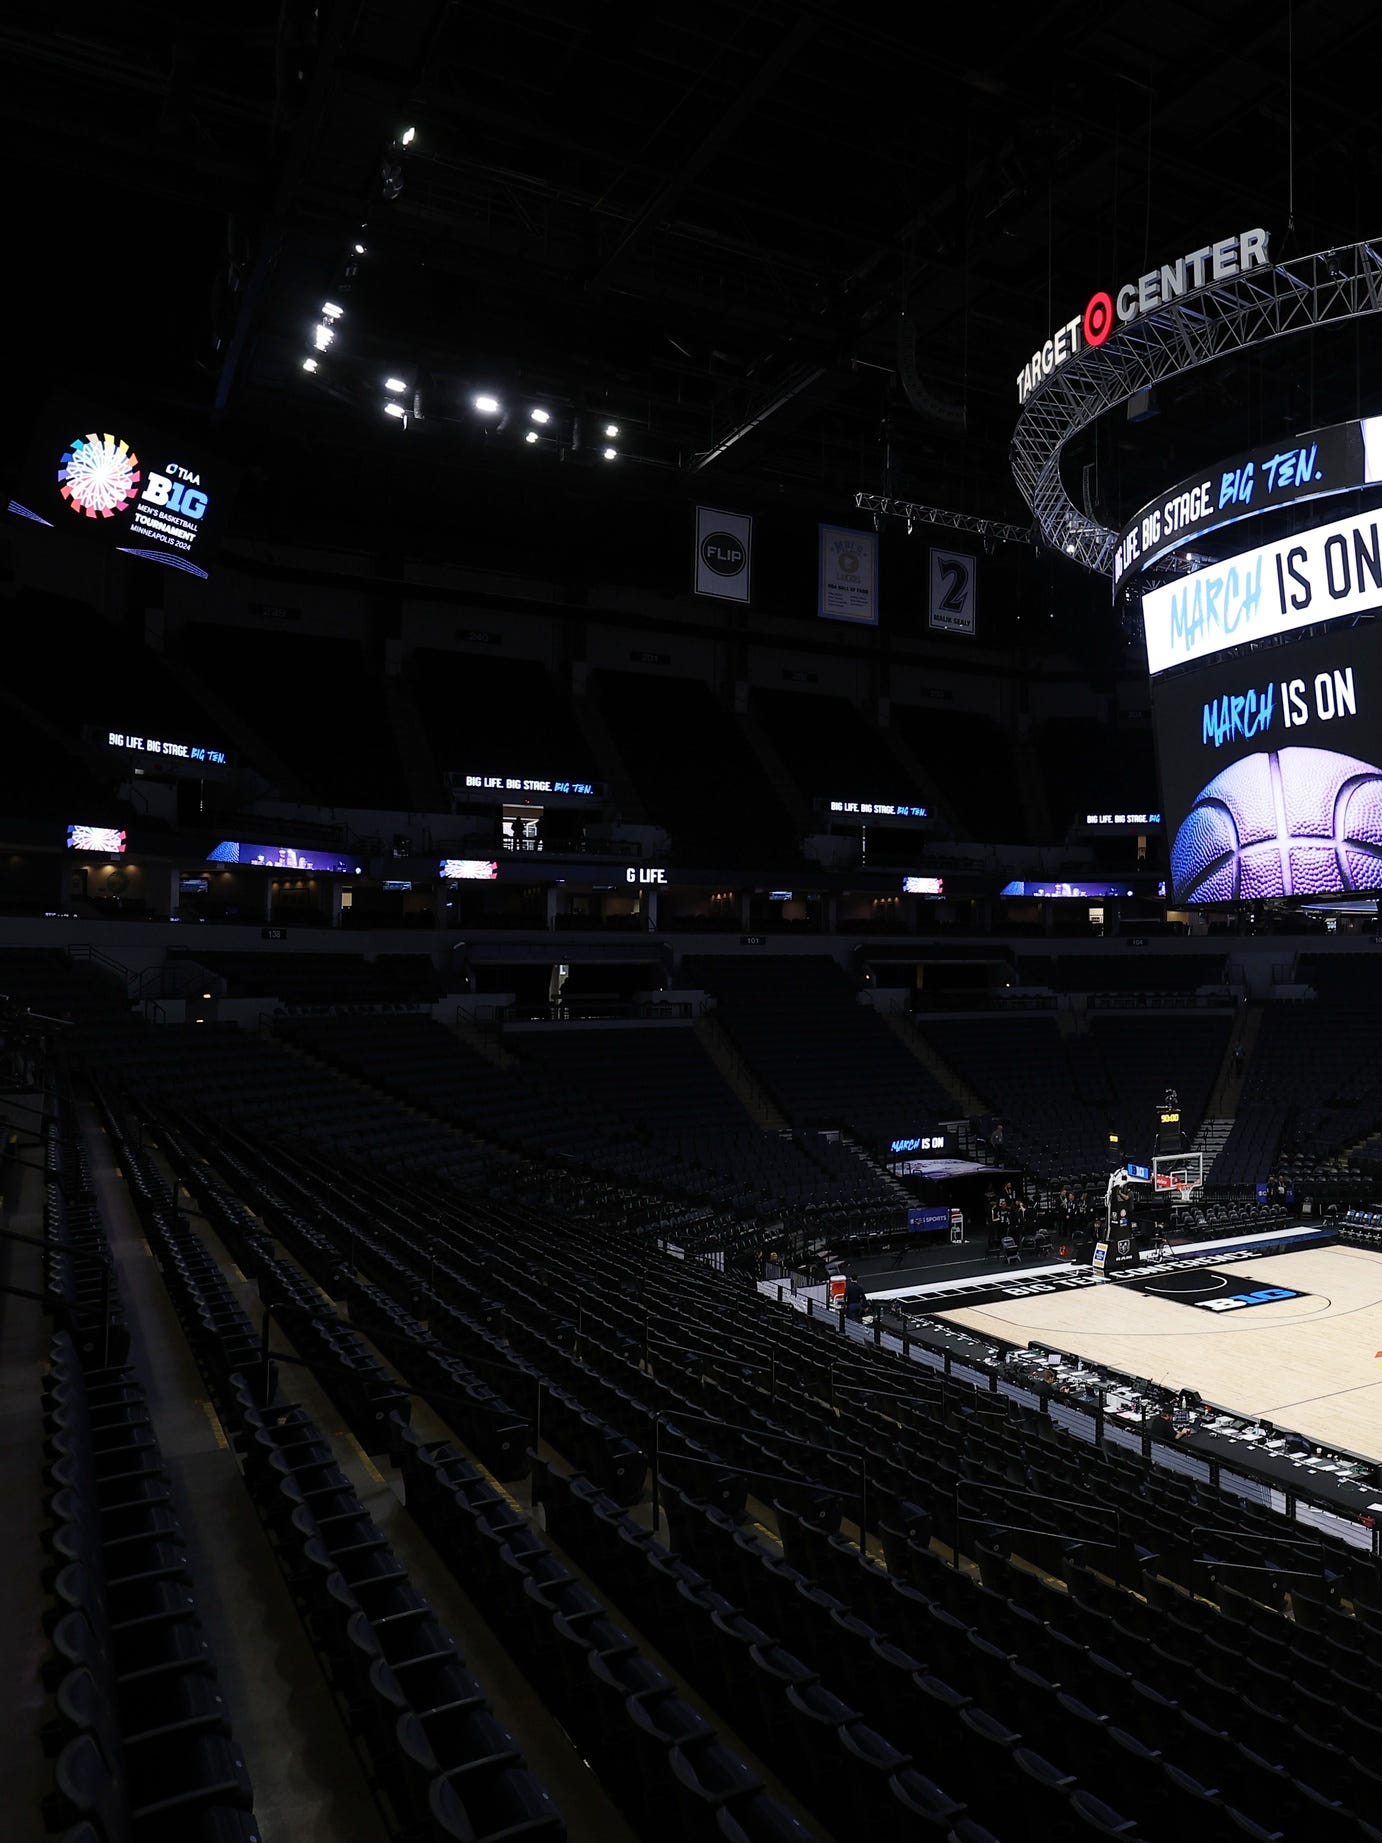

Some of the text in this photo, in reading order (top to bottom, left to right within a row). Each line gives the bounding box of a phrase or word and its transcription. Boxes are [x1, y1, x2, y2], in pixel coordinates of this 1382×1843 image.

[1016, 228, 1269, 404] TARGET CENTER
[178, 467, 200, 486] TIAA
[1142, 510, 1161, 552] BIG
[1163, 481, 1214, 536] STAGE.
[1218, 462, 1254, 510] BIG
[1262, 442, 1323, 493] TEN.
[135, 513, 196, 542] TOURNAMENT
[137, 504, 198, 532] MEN'S BASKETBALL
[130, 524, 191, 551] MINNEAPOLIS 2024
[706, 546, 741, 562] FLIP
[938, 557, 969, 613] 2
[1170, 555, 1263, 650] MARCH
[1276, 546, 1312, 614] IS
[1202, 667, 1357, 747] MARCH IS ON
[109, 733, 124, 746] BIG
[147, 740, 161, 753] BIG
[191, 748, 205, 761] BIG
[466, 776, 481, 787] BIG
[506, 779, 521, 790] BIG
[554, 782, 570, 793] BIG
[831, 801, 843, 811] BIG
[861, 804, 872, 813] BIG
[897, 806, 909, 816] BIG
[1087, 815, 1098, 824] BIG
[1115, 815, 1126, 824] BIG
[1149, 814, 1160, 823] BIG
[639, 868, 667, 883] LIFE.
[891, 1136, 944, 1152] MARCH IS ON
[1002, 1283, 1050, 1297] BIG
[1060, 1273, 1111, 1287] TEN
[1109, 1250, 1262, 1278] CONFERENCE
